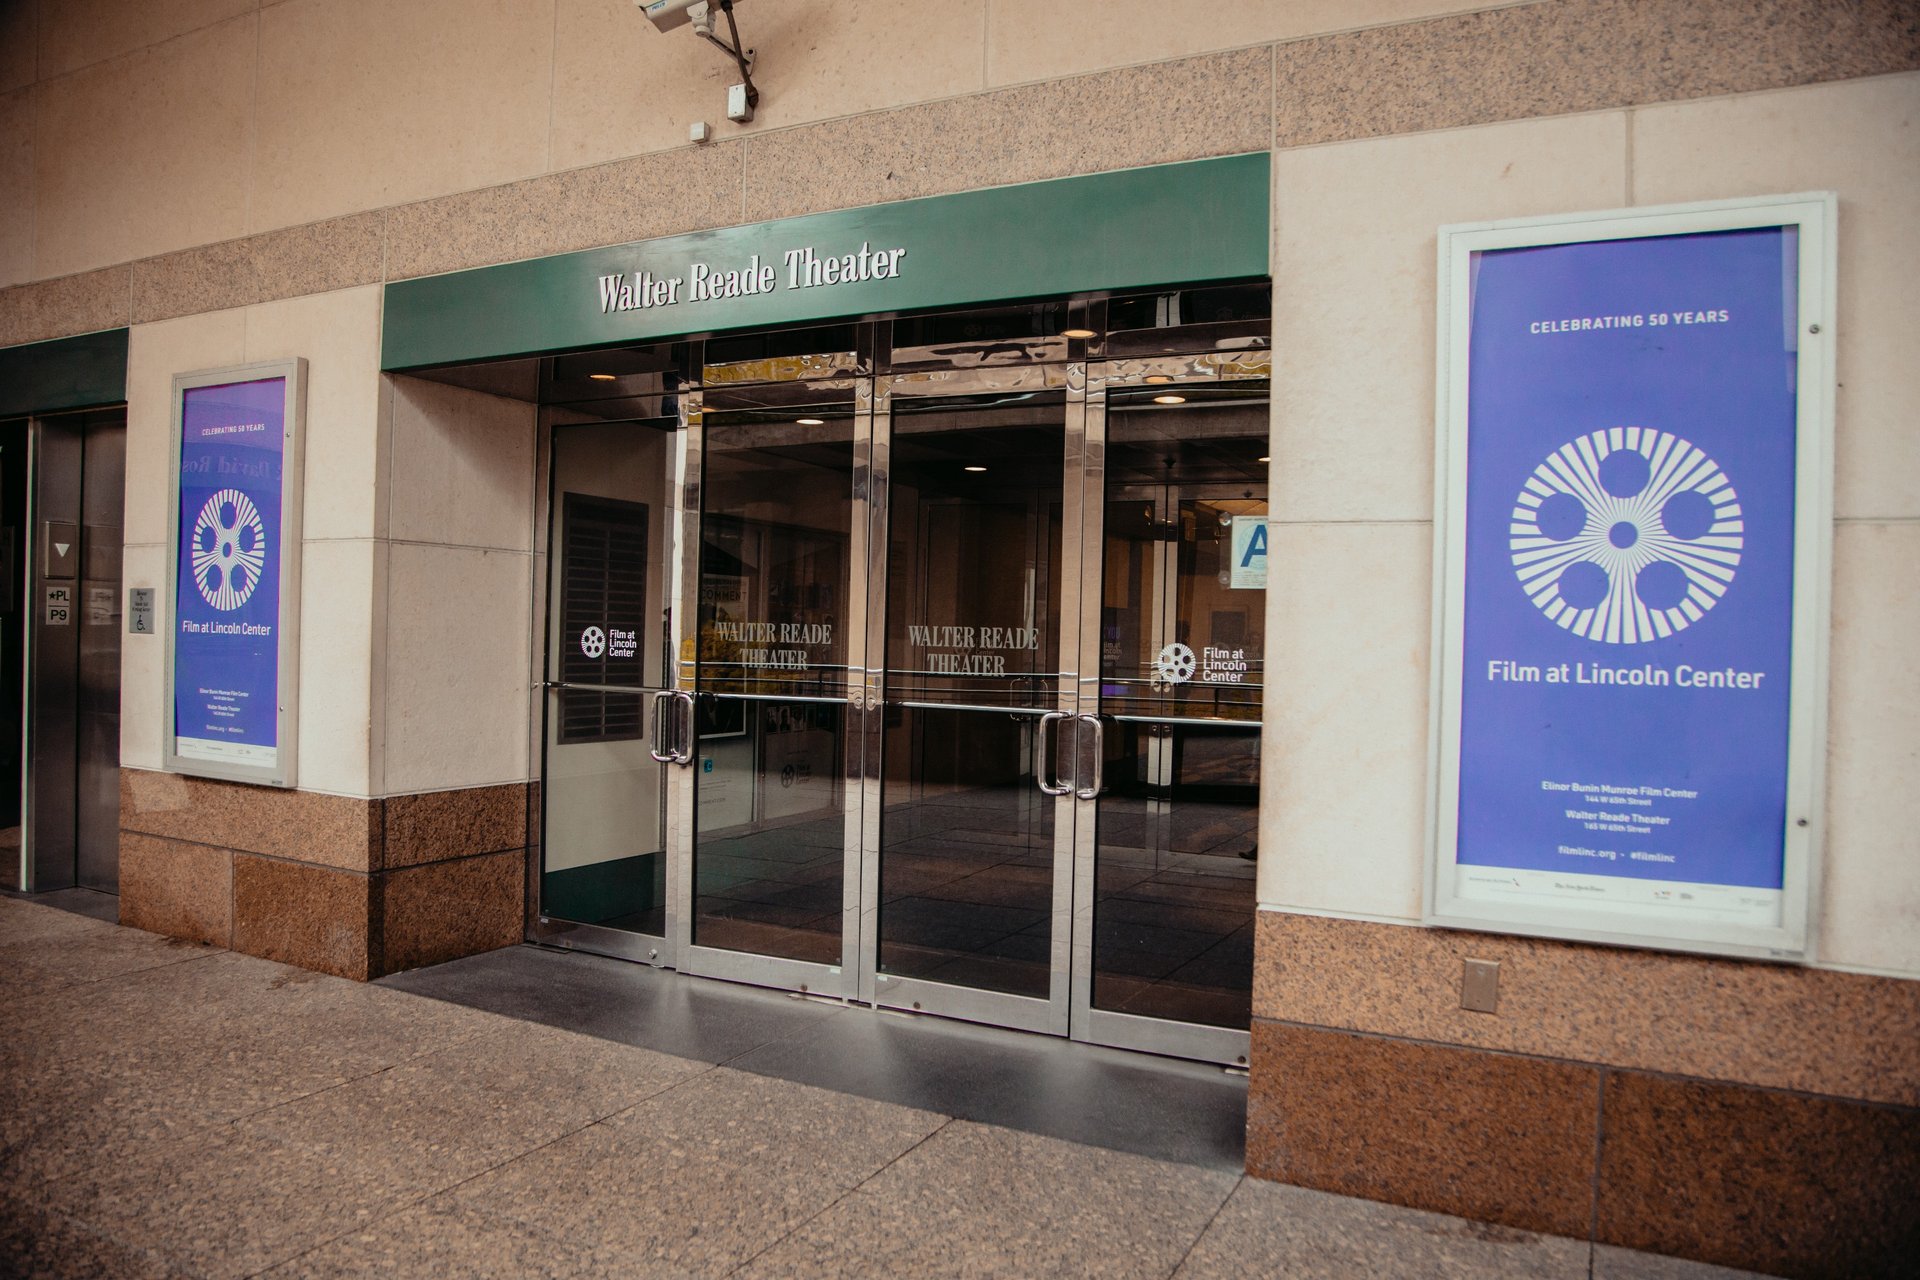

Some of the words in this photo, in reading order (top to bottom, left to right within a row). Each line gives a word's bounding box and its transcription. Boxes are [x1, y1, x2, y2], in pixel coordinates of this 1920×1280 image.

[599, 272, 683, 313] Walter
[689, 255, 776, 302] Reade
[784, 242, 906, 290] Theater
[1531, 315, 1644, 334] CELEBRATING
[1649, 313, 1668, 326] 50
[1673, 310, 1729, 324] YEARS
[202, 426, 236, 436] CELEBRATING
[1240, 525, 1267, 567] A
[51, 610, 66, 620] P9
[182, 620, 200, 632] Film
[201, 622, 209, 633] at
[211, 622, 240, 634] Lincoln
[242, 623, 271, 636] Center
[610, 630, 626, 638] Film
[628, 631, 635, 639] at
[717, 622, 776, 642] WALTER
[780, 624, 832, 644] READE
[610, 639, 636, 648] Lincoln
[909, 626, 975, 648] WALTER
[980, 627, 1038, 650] READE
[610, 648, 634, 657] Center
[740, 648, 808, 670] THEATER
[1203, 647, 1229, 659] Film
[1232, 648, 1244, 659] at
[928, 654, 1005, 677] THEATER
[1203, 659, 1247, 671] Lincoln
[1203, 670, 1243, 682] Center
[1488, 660, 1540, 682] Film
[1546, 664, 1569, 683] at
[1576, 663, 1669, 686] Lincoln
[1675, 665, 1765, 688] Center
[1542, 781, 1570, 792] Elinor
[1572, 782, 1600, 793] Bunin
[1601, 784, 1638, 795] Munroe
[1640, 786, 1662, 796] Film
[1663, 788, 1698, 798] Center
[1565, 810, 1598, 820] Walter
[1600, 811, 1630, 822] Reade
[1632, 814, 1670, 825] Theater
[1558, 846, 1616, 860] filmlinc.org
